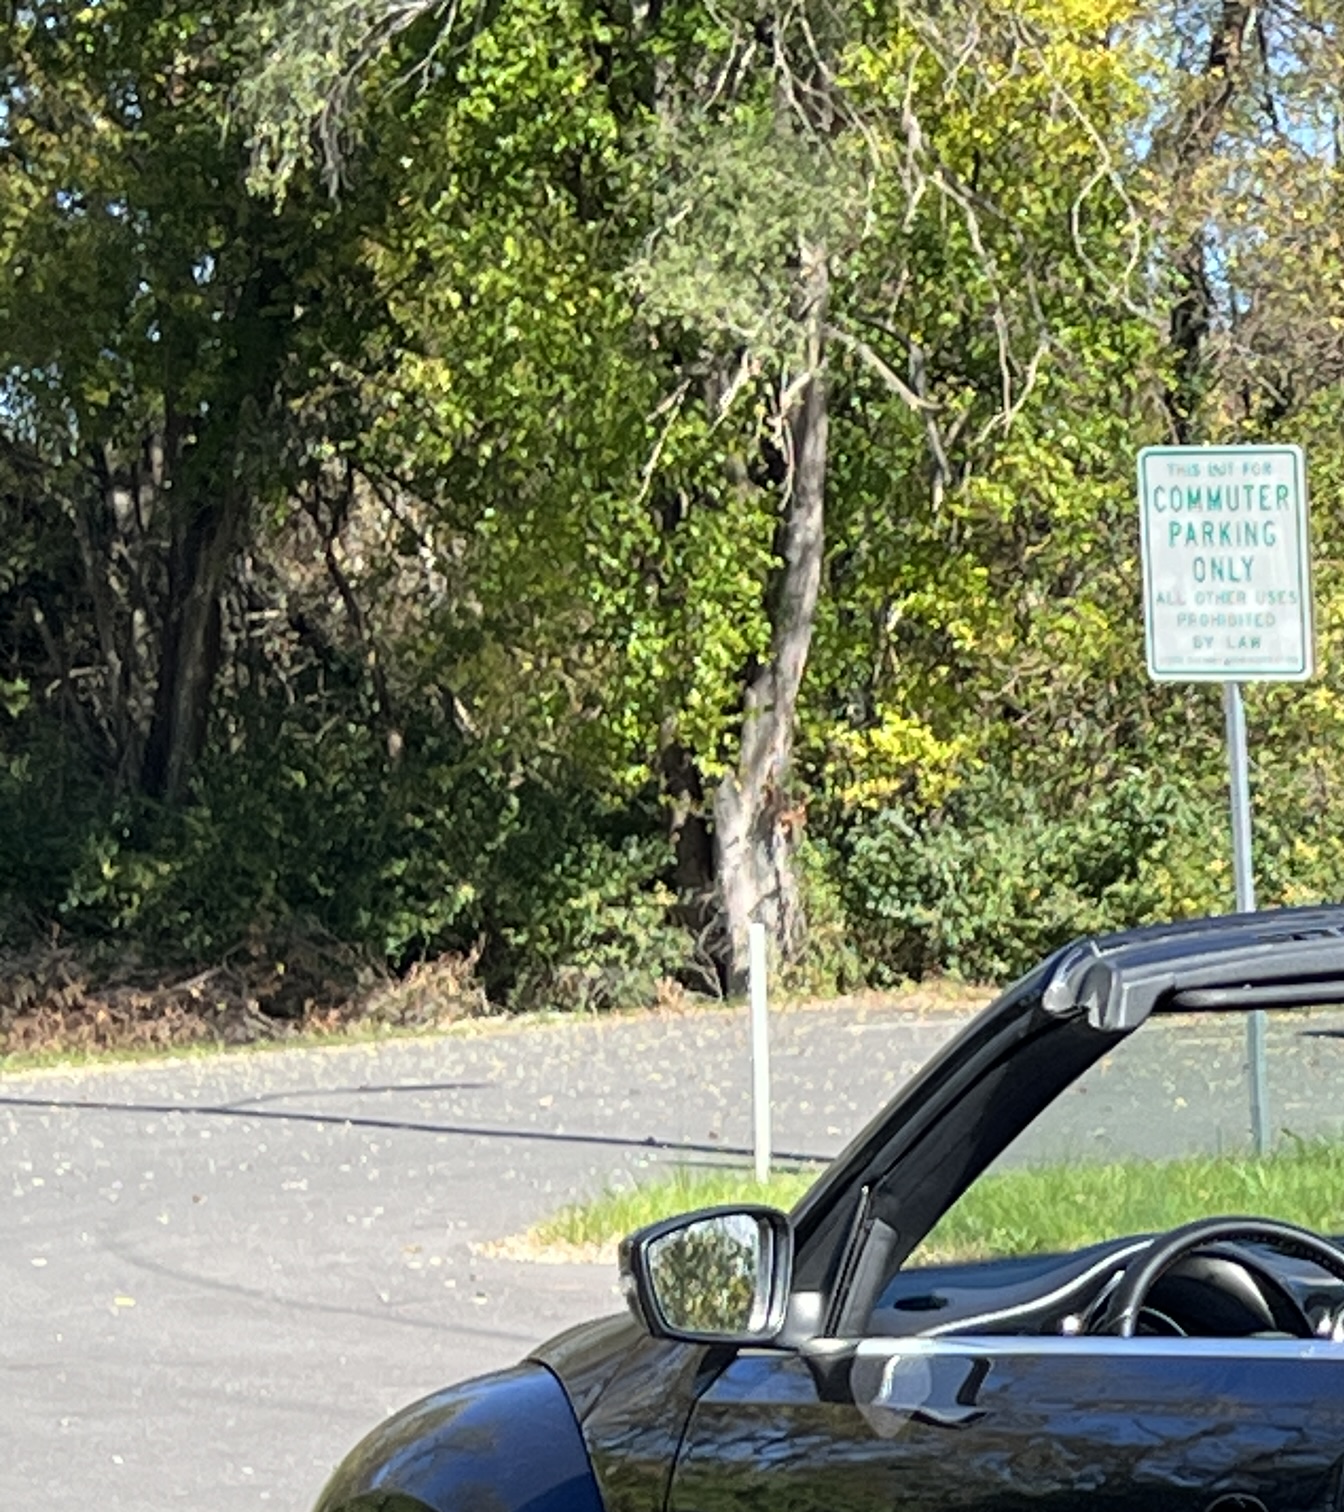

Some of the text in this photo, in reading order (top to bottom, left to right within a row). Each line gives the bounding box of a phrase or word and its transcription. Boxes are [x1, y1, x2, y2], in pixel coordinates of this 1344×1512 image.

[1167, 461, 1272, 477] THIS LOT FOR
[1153, 484, 1290, 513] COMMUTER
[1168, 520, 1277, 548] PARKING
[1192, 556, 1255, 583] ONLY
[1156, 590, 1298, 606] ALL OTHER USES
[1177, 613, 1277, 628] PROHIBITED
[1193, 635, 1262, 650] BY LAW
